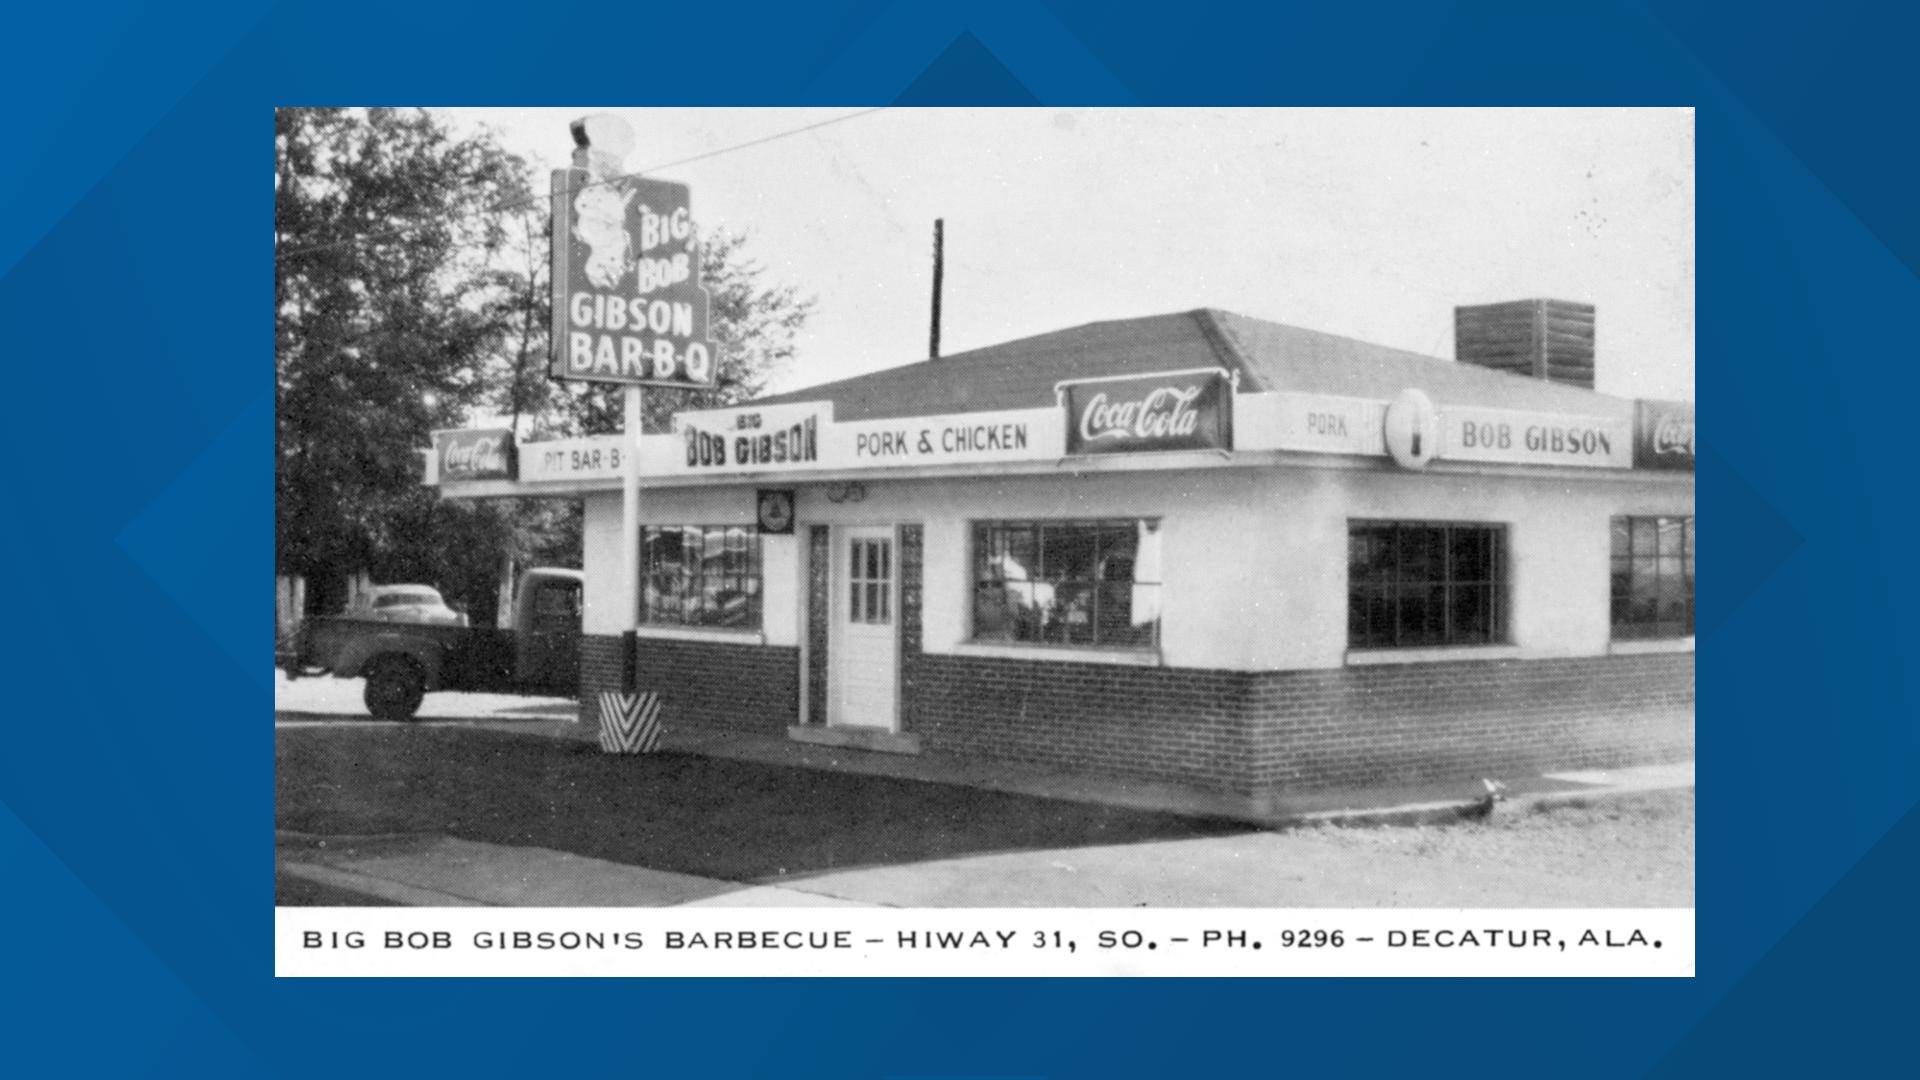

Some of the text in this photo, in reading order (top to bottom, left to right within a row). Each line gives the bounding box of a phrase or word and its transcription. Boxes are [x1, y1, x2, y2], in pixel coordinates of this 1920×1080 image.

[638, 204, 690, 251] BIG
[637, 252, 690, 294] BOB
[570, 291, 692, 338] GIBSON
[569, 331, 710, 383] BAR-B-Q
[736, 412, 761, 430] BIG
[1080, 385, 1203, 442] Coca-Cola
[1306, 411, 1348, 437] PORK
[684, 413, 817, 467] BOB GIBSON
[856, 423, 1027, 457] PORK & CHICKEN
[1462, 420, 1612, 457] BOB GIBSON
[544, 448, 626, 472] PIT BAR-B-
